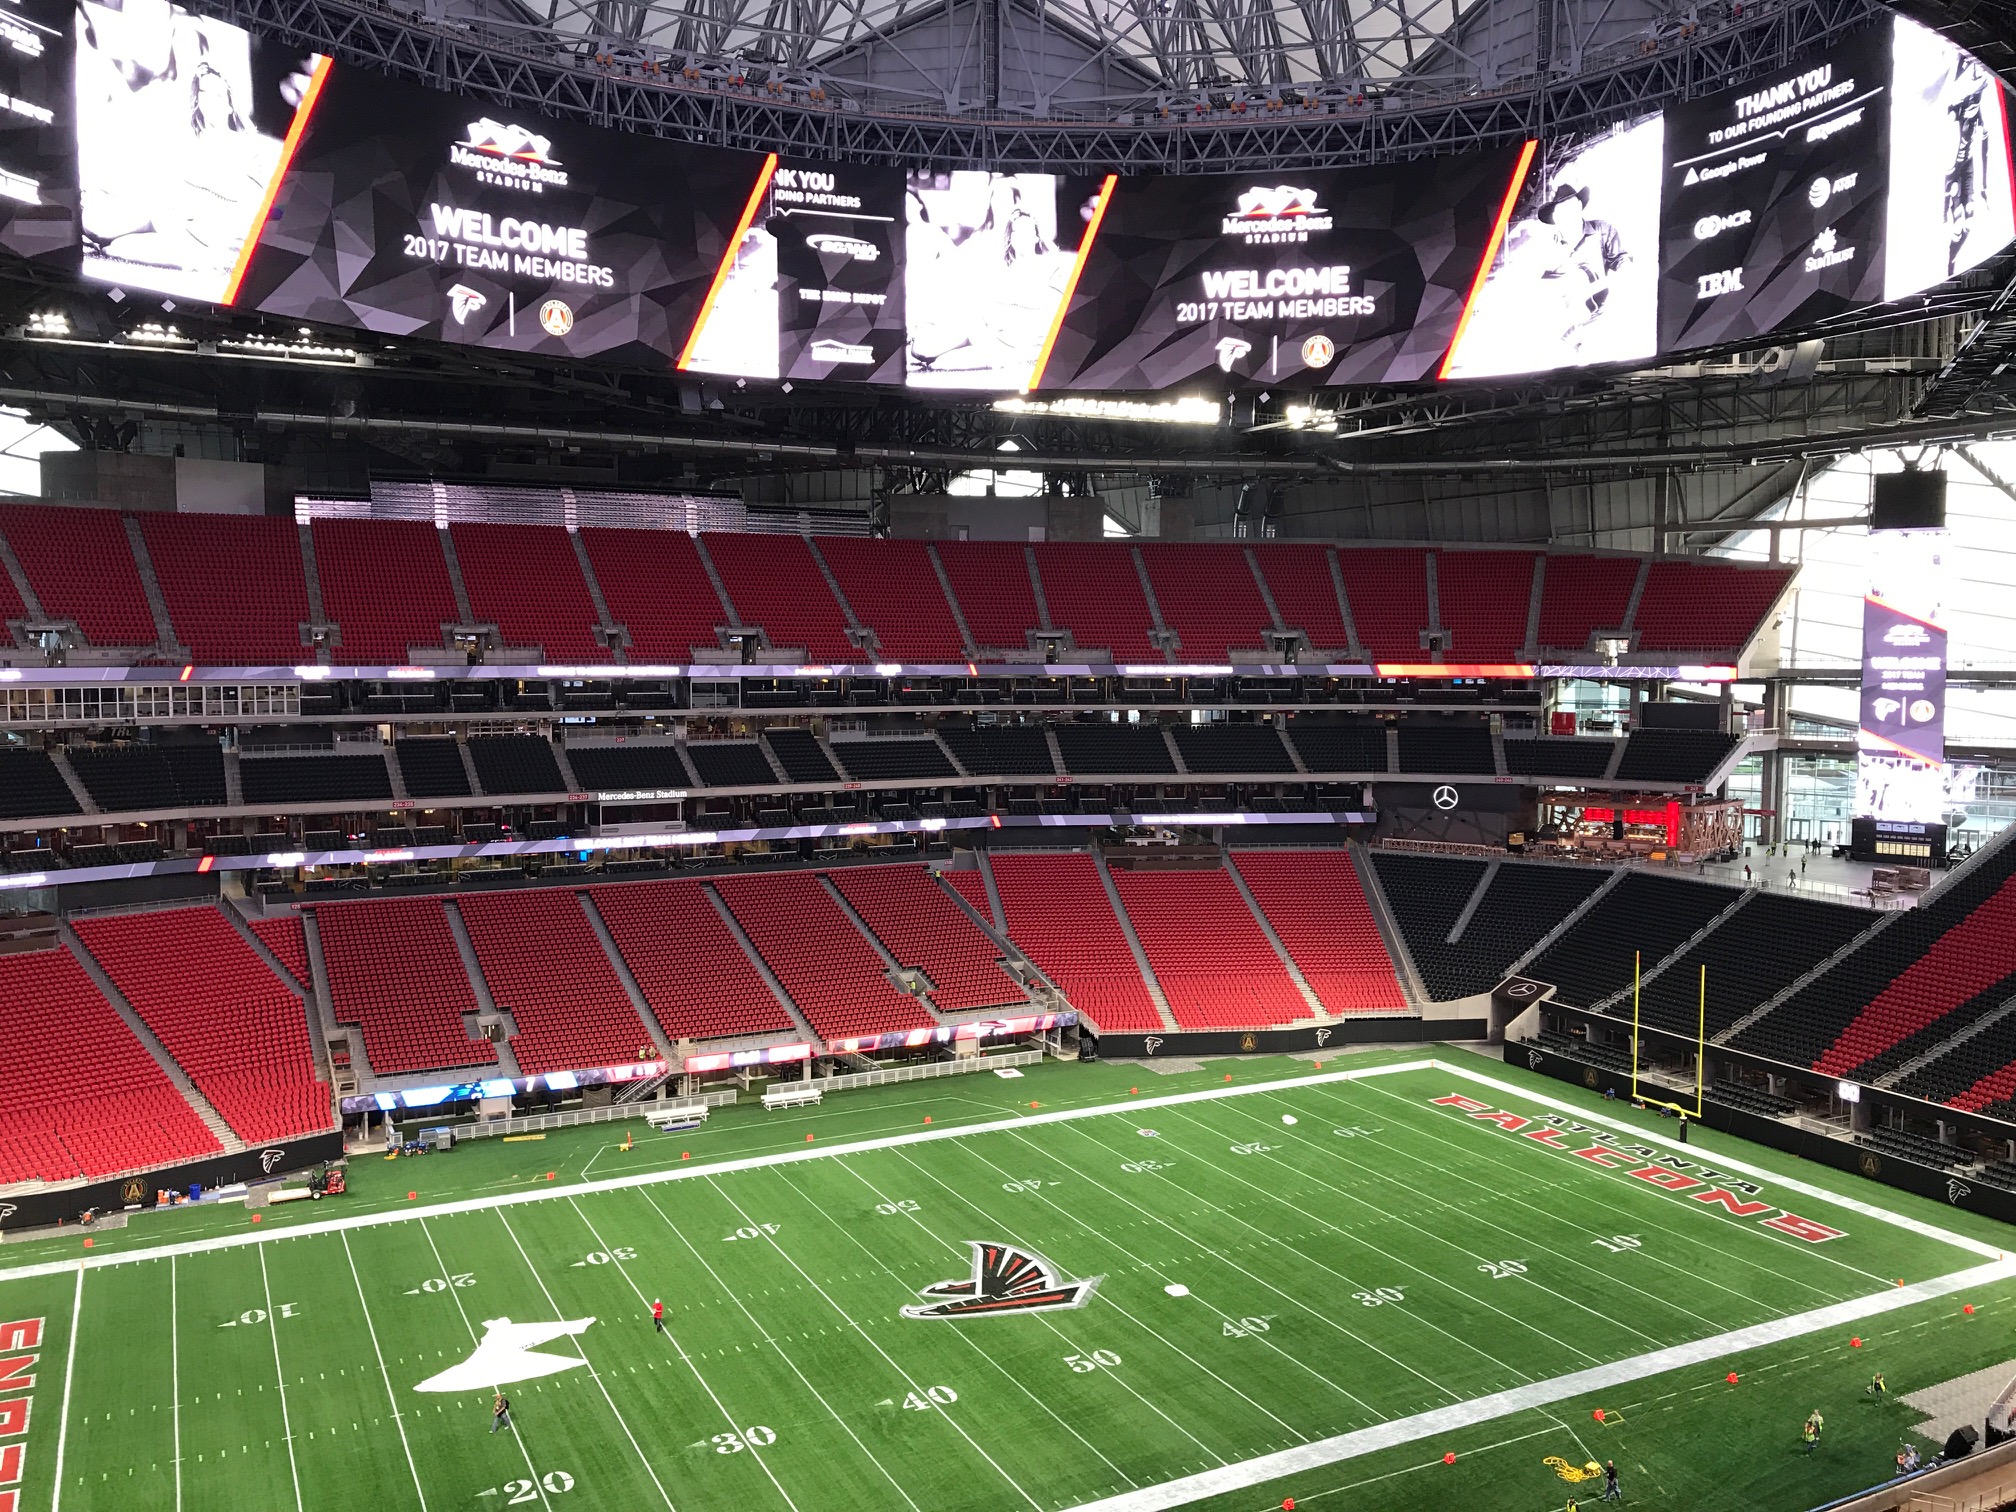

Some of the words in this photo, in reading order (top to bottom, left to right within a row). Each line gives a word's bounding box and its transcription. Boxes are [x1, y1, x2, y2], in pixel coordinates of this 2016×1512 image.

[1736, 79, 1796, 118] THANK
[1797, 63, 1831, 96] YOU
[1708, 131, 1723, 144] TO
[1724, 122, 1747, 138] OUR
[1748, 102, 1801, 132] FOUNDING
[1803, 78, 1854, 111] PARTNERS
[450, 146, 568, 185] Mercedes-Benz
[1700, 162, 1737, 181] Georgia
[1738, 152, 1767, 169] Power
[476, 171, 543, 193] STADIUM
[800, 170, 834, 192] YOU
[806, 194, 861, 208] PARTNERS
[1222, 215, 1333, 234] Mercedes-Benz
[1722, 210, 1751, 230] NCR
[431, 203, 588, 260] WELCOME
[1246, 232, 1308, 244] STADIUM
[404, 234, 450, 262] 2017
[453, 243, 510, 272] TEAM
[514, 253, 614, 288] MEMBERS
[1202, 266, 1350, 298] WELCOME
[1176, 302, 1218, 322] 2017
[1222, 301, 1274, 320] TEAM
[1279, 296, 1376, 318] MEMBERS
[598, 791, 654, 800] Mercedes-Benz
[656, 790, 688, 798] Stadium
[1533, 1113, 1765, 1196] ATLANTA
[1120, 1160, 1163, 1173] 30
[1434, 1092, 1850, 1244] FALCONS
[1002, 1179, 1043, 1194] 40
[875, 1200, 922, 1215] 50
[736, 1222, 781, 1239] 40
[1592, 1234, 1641, 1254] 10
[586, 1247, 638, 1266] 30
[1478, 1260, 1528, 1279] 20
[422, 1273, 476, 1294] 20
[1350, 1286, 1404, 1308] 30
[240, 1302, 300, 1324] 10
[1222, 1316, 1270, 1339] 40
[1063, 1350, 1122, 1374] 50
[902, 1386, 958, 1412] 40
[711, 1426, 776, 1454] 30
[503, 1470, 575, 1505] 20
